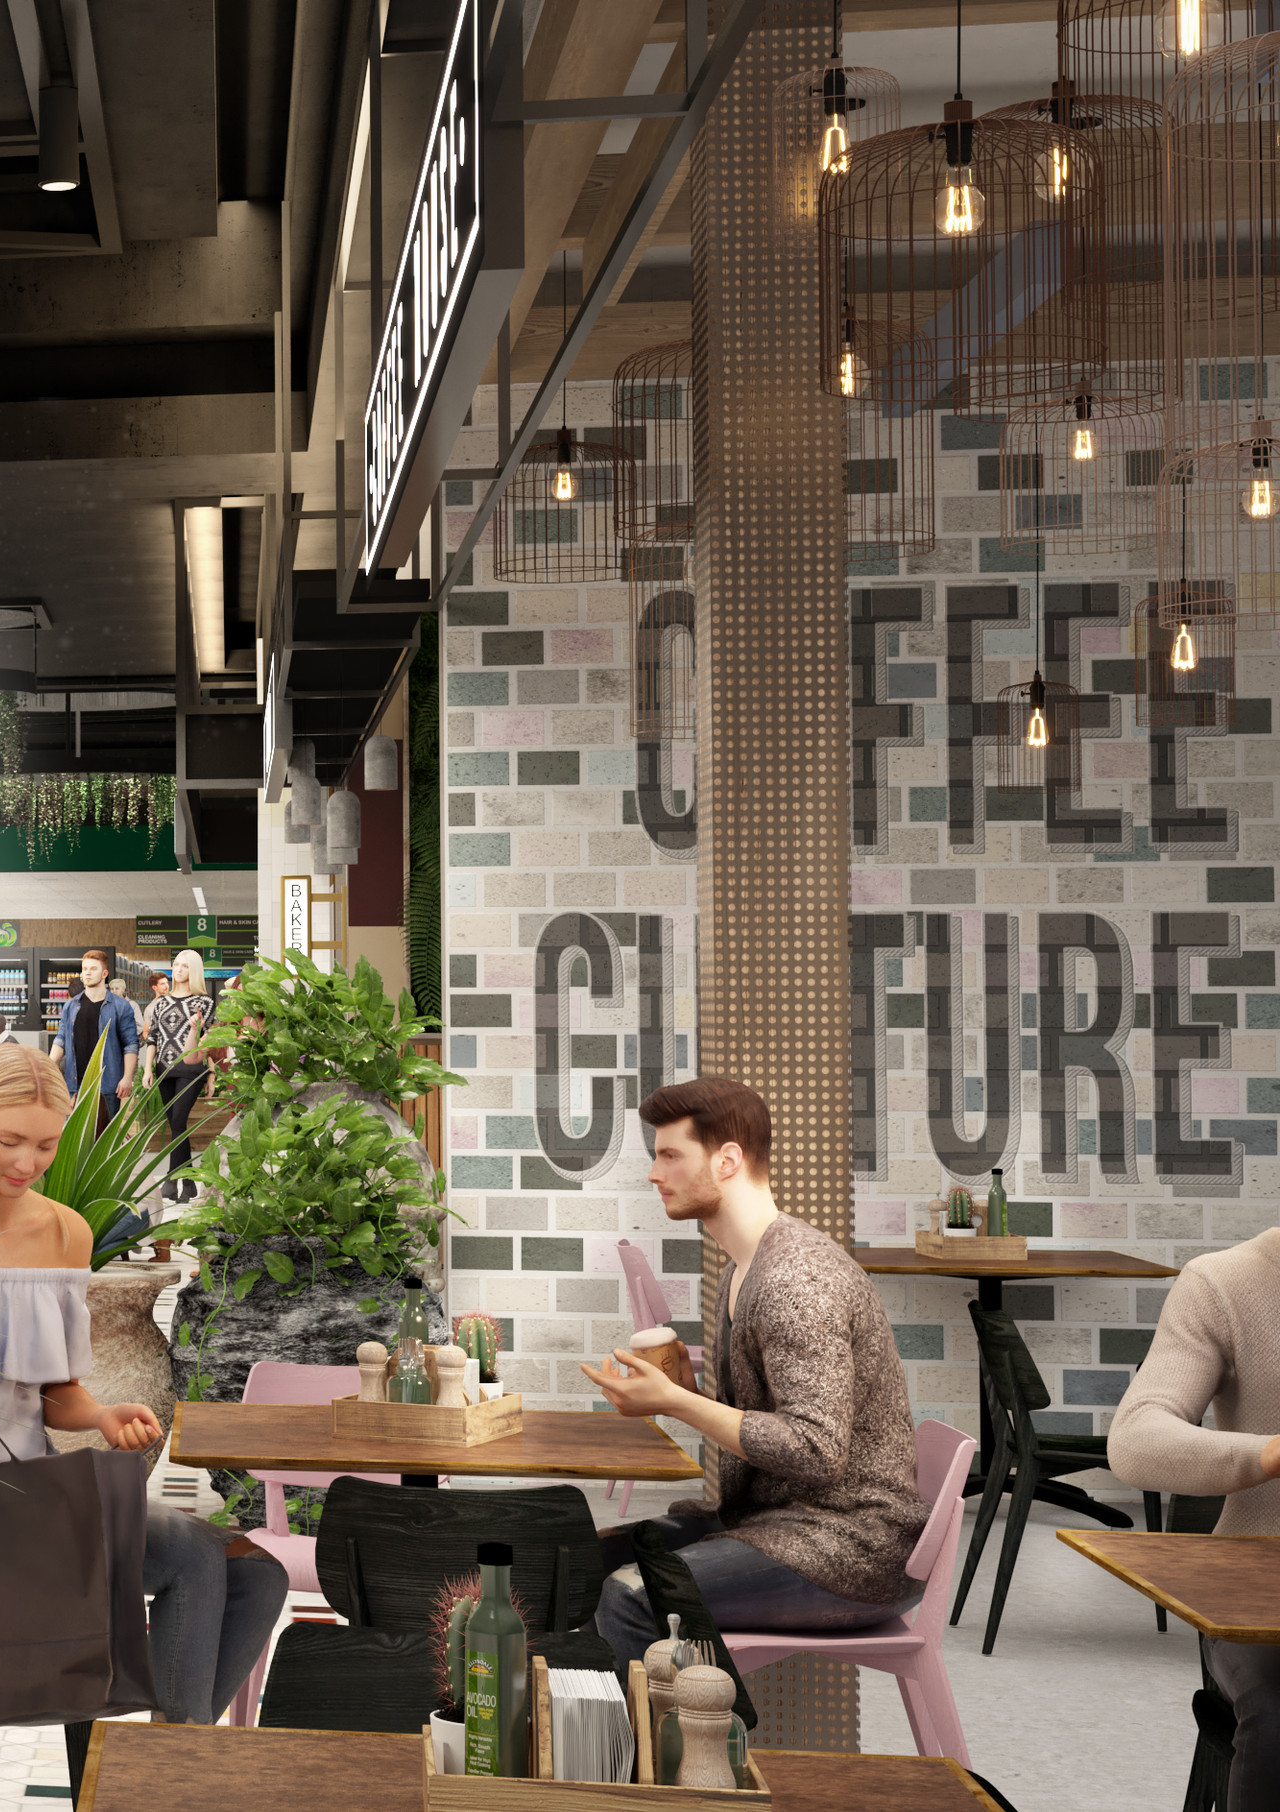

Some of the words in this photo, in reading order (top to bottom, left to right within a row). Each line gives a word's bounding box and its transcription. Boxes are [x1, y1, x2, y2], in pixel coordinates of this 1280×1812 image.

[635, 583, 1240, 856] CFFEE
[197, 917, 207, 932] 8
[290, 884, 302, 954] BAKER
[209, 949, 216, 958] 8
[533, 909, 1243, 1186] CTURE
[466, 1690, 497, 1708] AVOCADO
[466, 1704, 478, 1719] OIL
